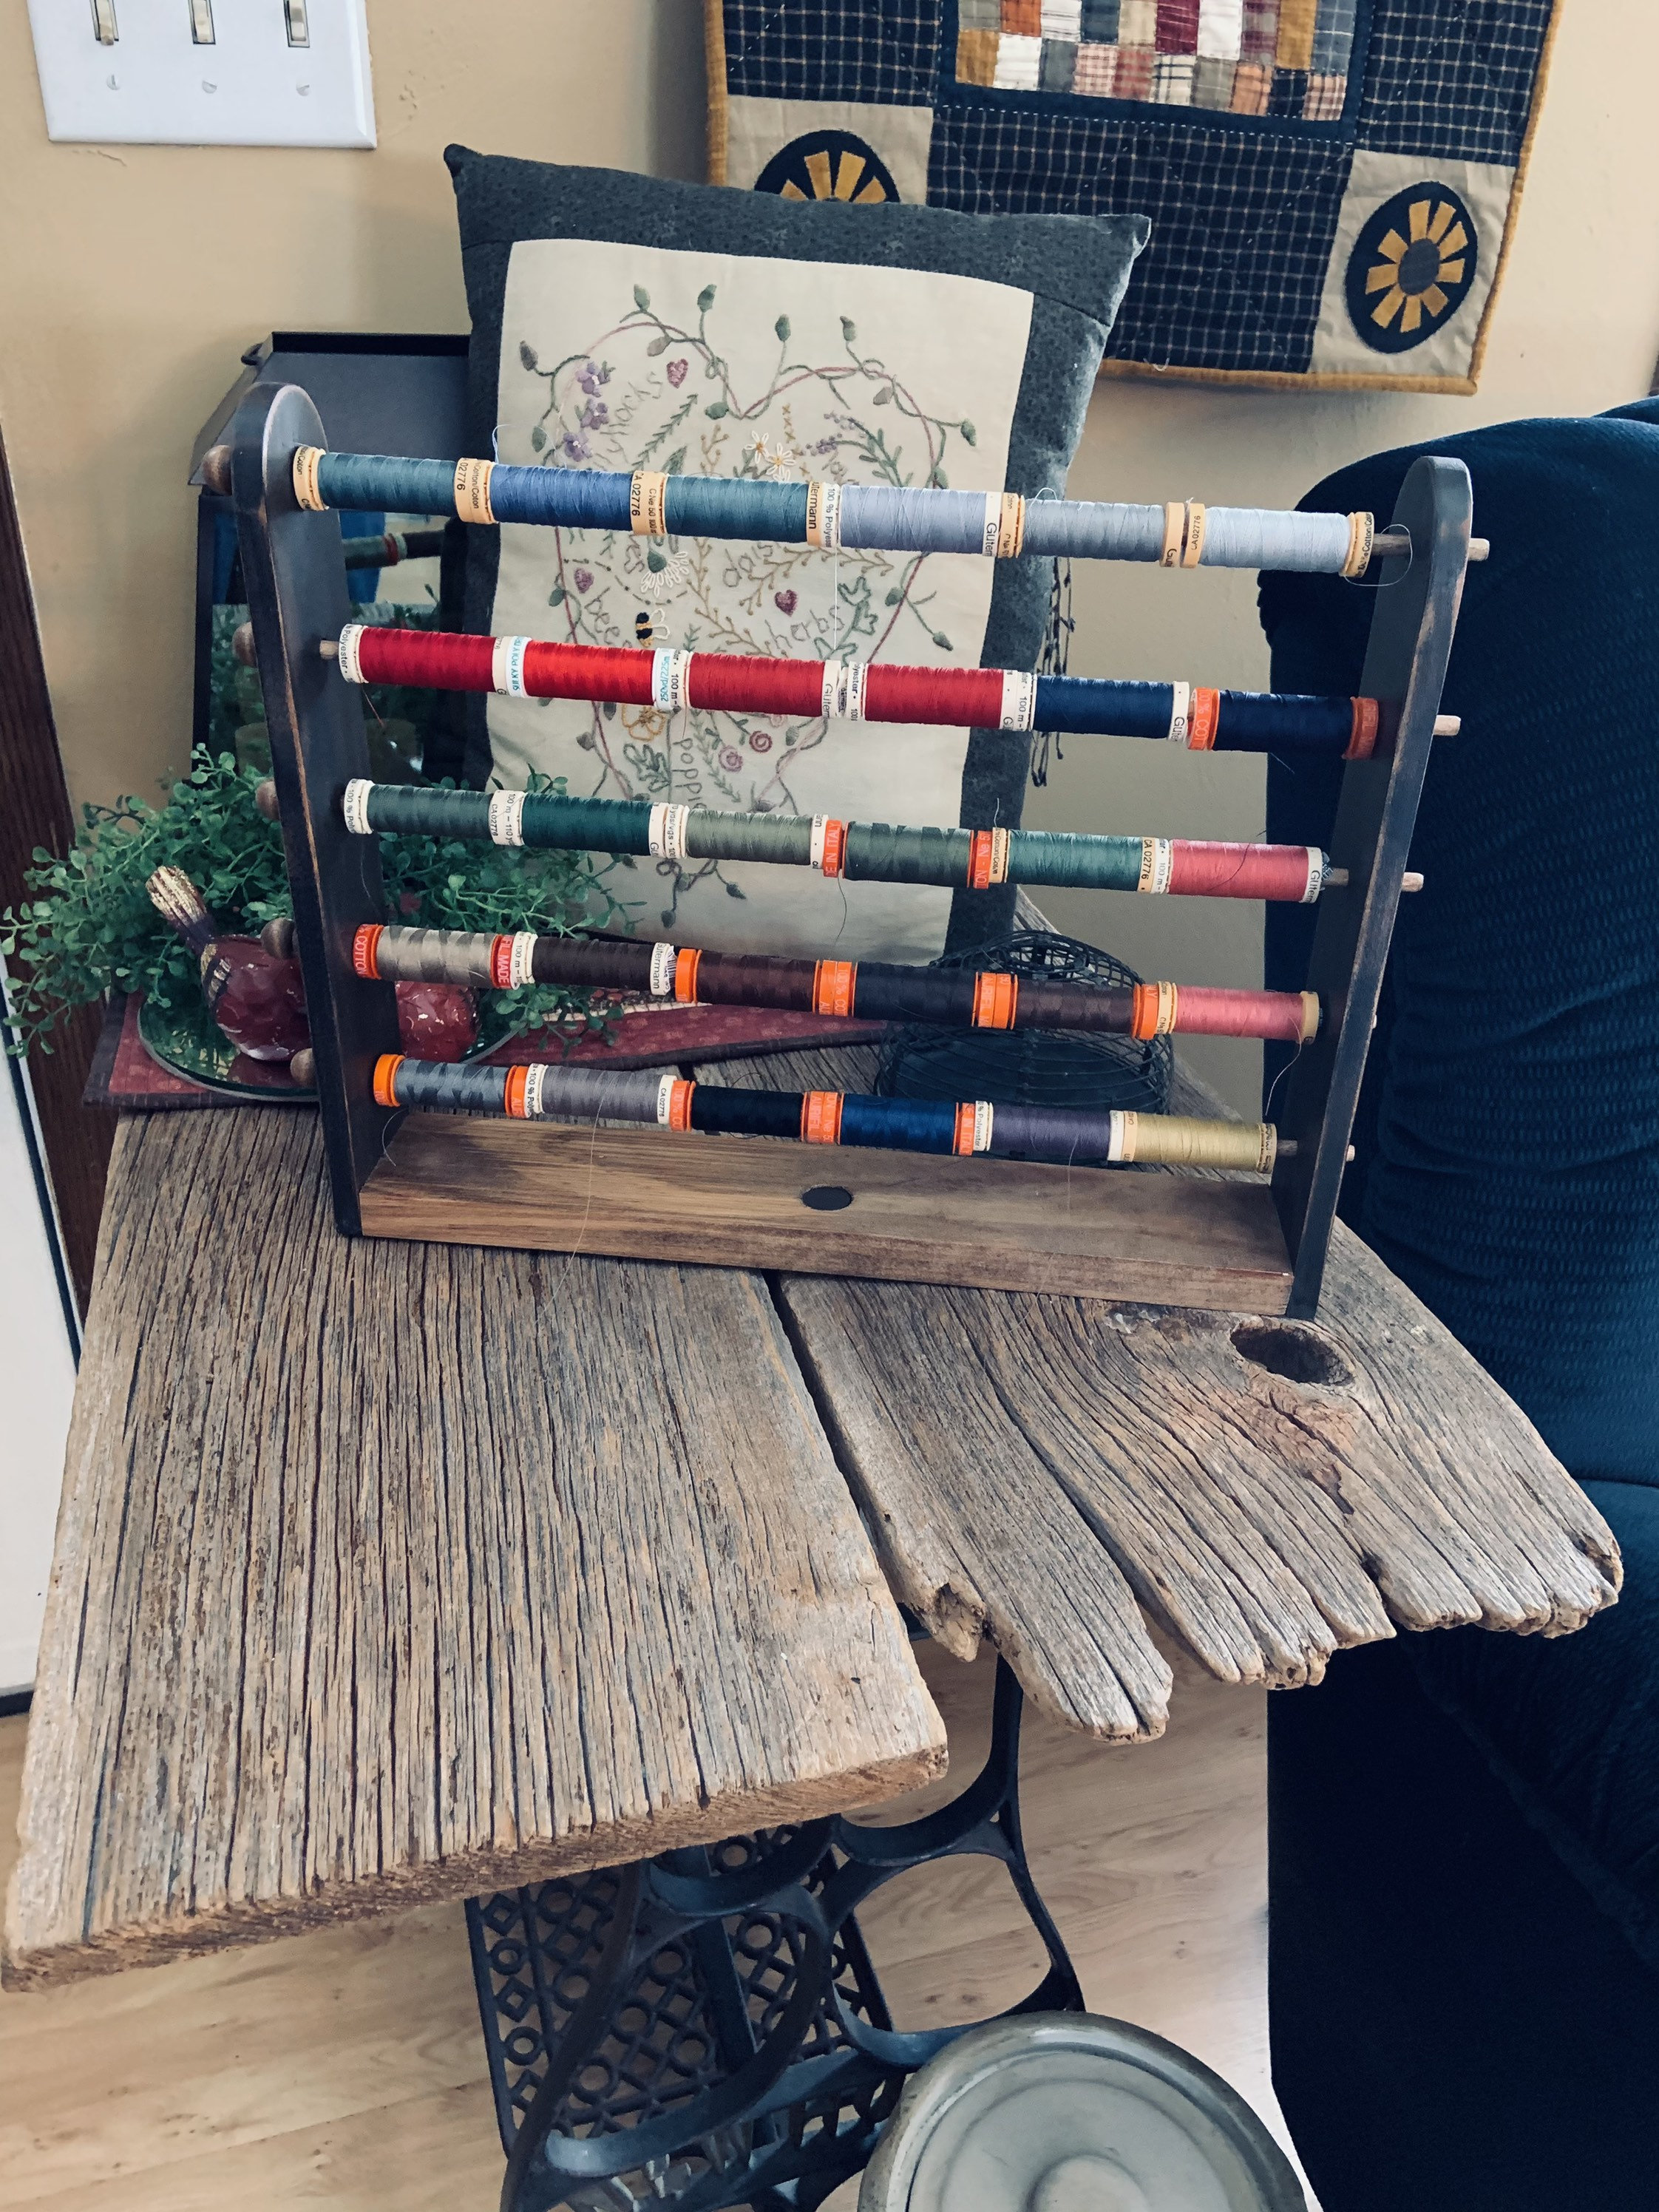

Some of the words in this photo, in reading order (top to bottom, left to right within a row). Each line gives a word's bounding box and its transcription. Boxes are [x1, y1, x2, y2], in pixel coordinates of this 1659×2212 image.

[632, 484, 642, 516] 02776
[827, 489, 835, 501] 100
[584, 587, 632, 648] bee
[340, 631, 351, 669] Polyester
[1020, 696, 1028, 712] 100
[507, 793, 516, 804] 100
[827, 822, 840, 847] ITALY
[1144, 840, 1153, 849] CA
[826, 852, 838, 863] IN
[1141, 851, 1152, 880] 02776
[354, 935, 368, 974] COTTON
[498, 954, 510, 983] MADE
[529, 1073, 537, 1085] 100
